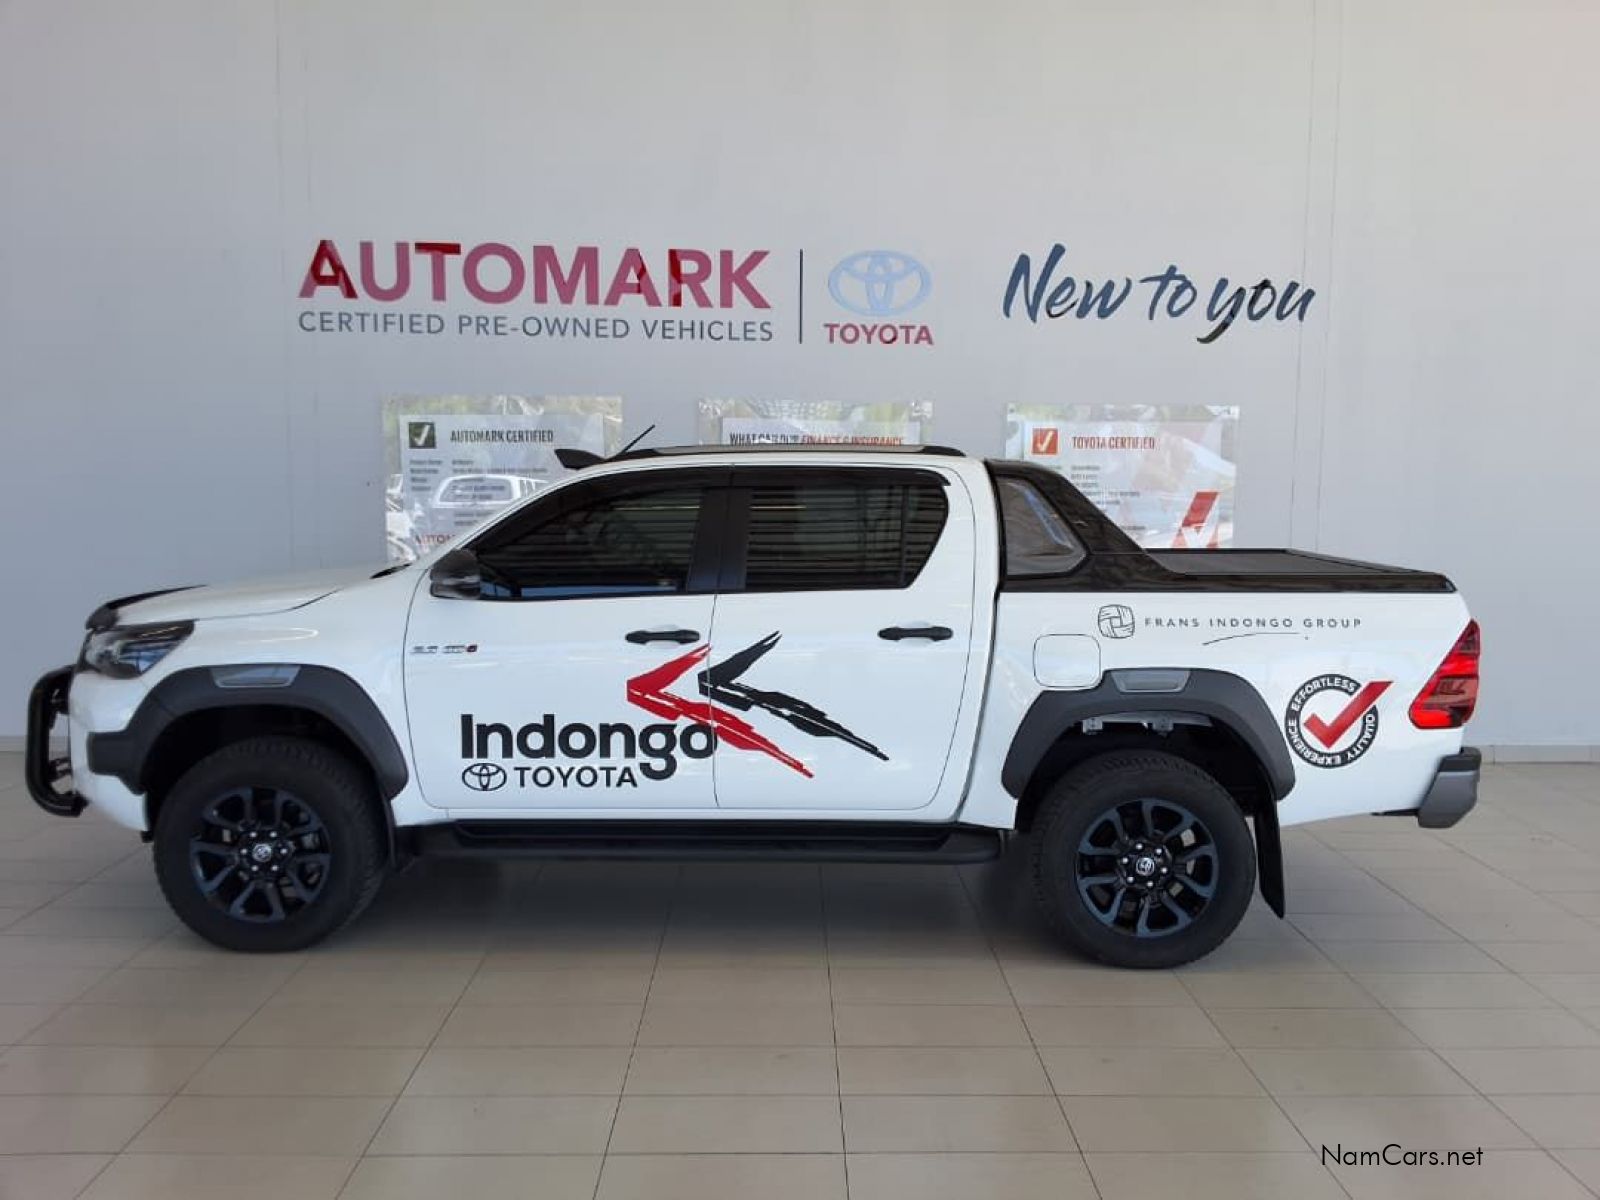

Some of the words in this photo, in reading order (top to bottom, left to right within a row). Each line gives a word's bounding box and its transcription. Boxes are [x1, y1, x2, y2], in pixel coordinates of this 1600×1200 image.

[299, 239, 772, 309] AUTOMARK
[1003, 243, 1132, 324] New
[1140, 264, 1197, 320] to
[1197, 277, 1316, 344] you
[298, 311, 446, 335] CERTIFIED
[457, 315, 630, 339] PRE-OWNED
[641, 319, 774, 342] VEHICLES
[824, 323, 934, 346] TOYOTA
[450, 429, 505, 444] AUTOMARK
[506, 430, 554, 444] CERTIFIED
[1072, 436, 1107, 450] TOYOTA
[1109, 436, 1155, 450] CERTIFIED
[1145, 617, 1201, 628] FRANS
[1209, 618, 1293, 628] INDONGO
[1303, 618, 1362, 628] GROUP
[1291, 676, 1357, 712] EFFORTLESS
[461, 713, 718, 780] Indongo
[514, 766, 638, 788] TOYOTA
